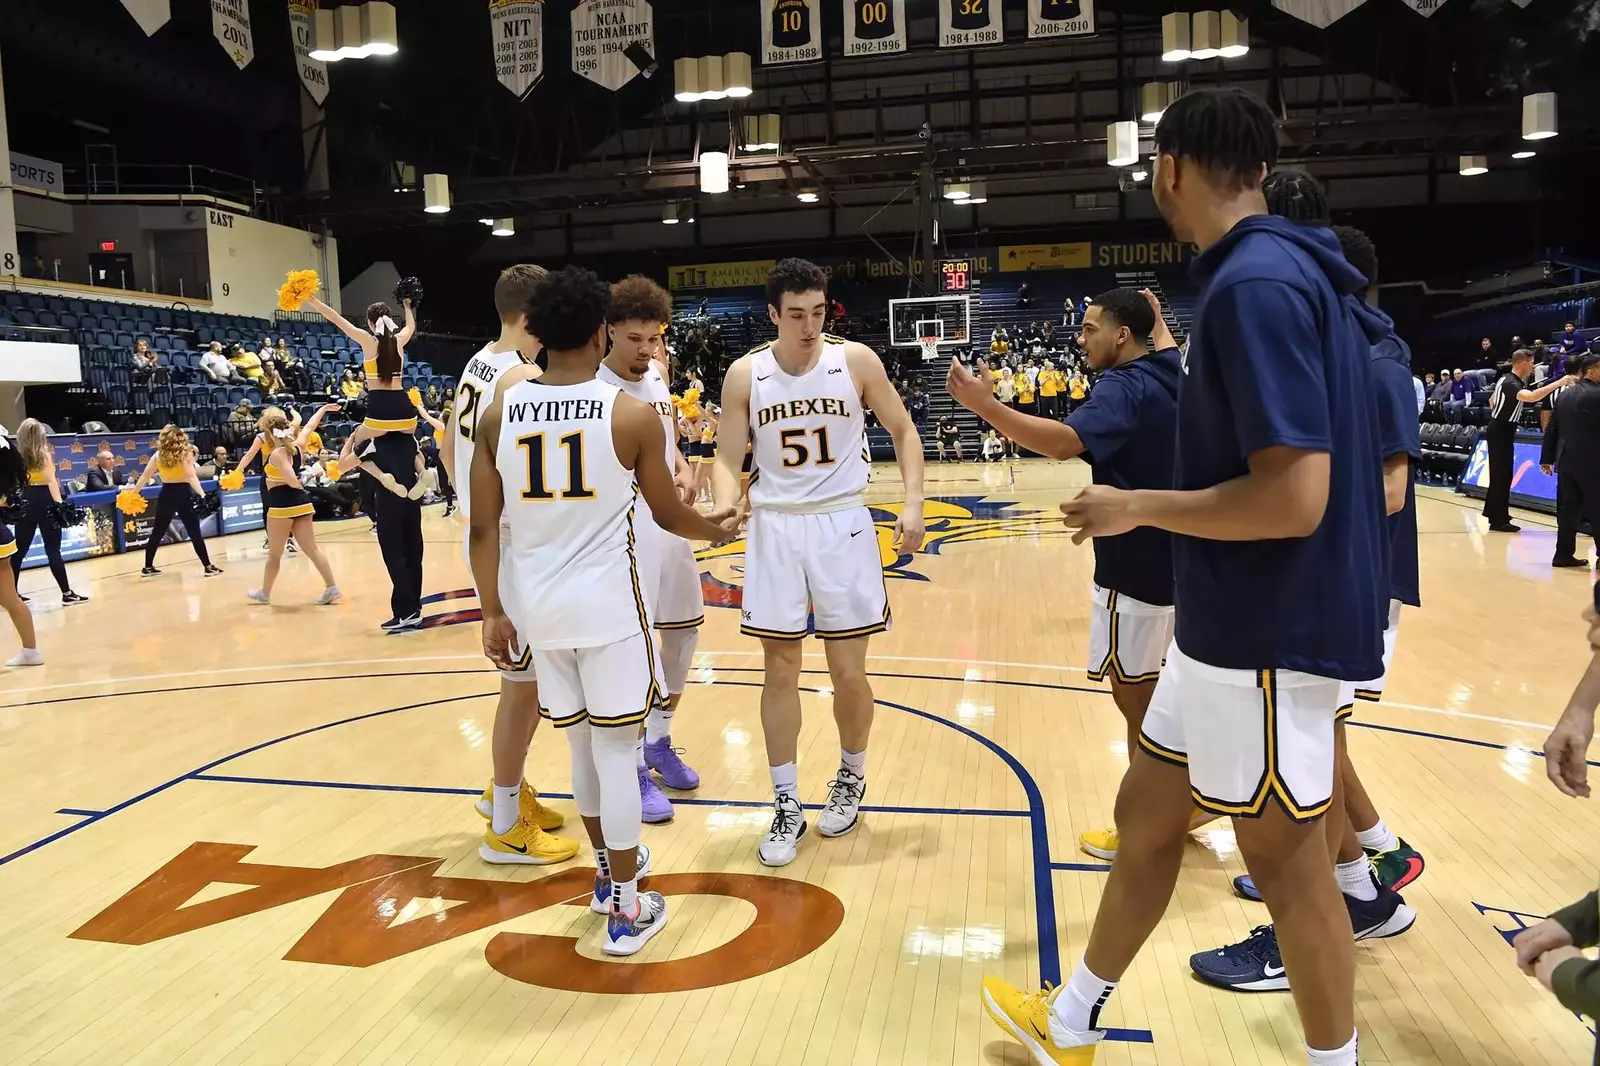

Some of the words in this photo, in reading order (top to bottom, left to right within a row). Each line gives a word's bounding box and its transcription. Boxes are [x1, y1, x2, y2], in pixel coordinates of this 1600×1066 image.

[862, 2, 887, 24] 00
[959, 0, 983, 15] 32
[596, 11, 626, 27] NCAA
[781, 10, 802, 32] 10
[1034, 20, 1089, 35] 2006-2010
[222, 23, 248, 50] 2013
[503, 19, 531, 38] NIT
[575, 22, 649, 42] TOURNAMENT
[497, 41, 515, 52] 1997
[518, 38, 538, 49] 2003
[945, 31, 998, 45] 1984-1988
[575, 45, 597, 57] 1986
[602, 41, 624, 54] 1994
[767, 47, 818, 62] 1984-1988
[851, 40, 900, 54] 1992-1996
[496, 53, 516, 64] 2004
[518, 51, 539, 61] 2005
[575, 59, 598, 71] 1996
[303, 63, 325, 86] 2009
[496, 65, 516, 76] 2007
[519, 62, 537, 74] 2012
[209, 210, 234, 229] EAST
[4, 252, 15, 270] 8
[1098, 242, 1184, 267] STUDENT
[942, 262, 969, 273] 20:00
[711, 277, 761, 287] CAMPU
[946, 272, 966, 289] 30
[222, 282, 230, 297] 9
[457, 381, 483, 443] 21
[509, 399, 604, 423] WYNTER
[757, 398, 850, 428] DREXEL
[779, 424, 836, 469] 51
[515, 429, 597, 502] 11
